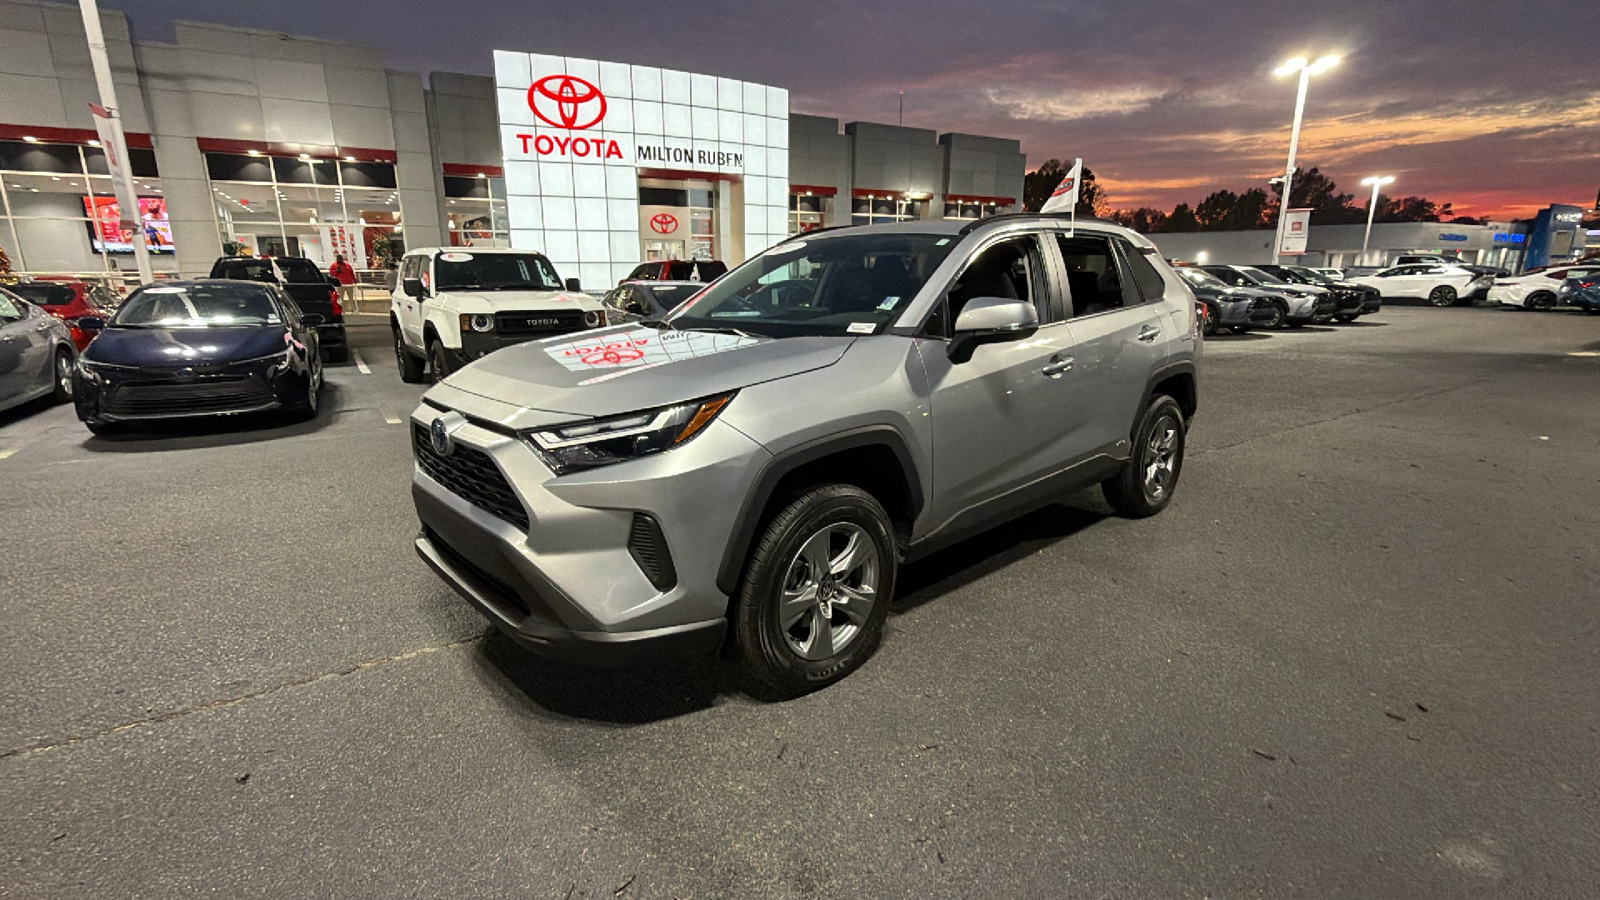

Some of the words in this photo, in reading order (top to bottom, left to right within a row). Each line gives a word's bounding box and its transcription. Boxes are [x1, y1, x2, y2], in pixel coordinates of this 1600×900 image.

[516, 134, 623, 159] TOYOTA
[637, 145, 693, 164] MILTON
[526, 318, 560, 326] TOYOTA
